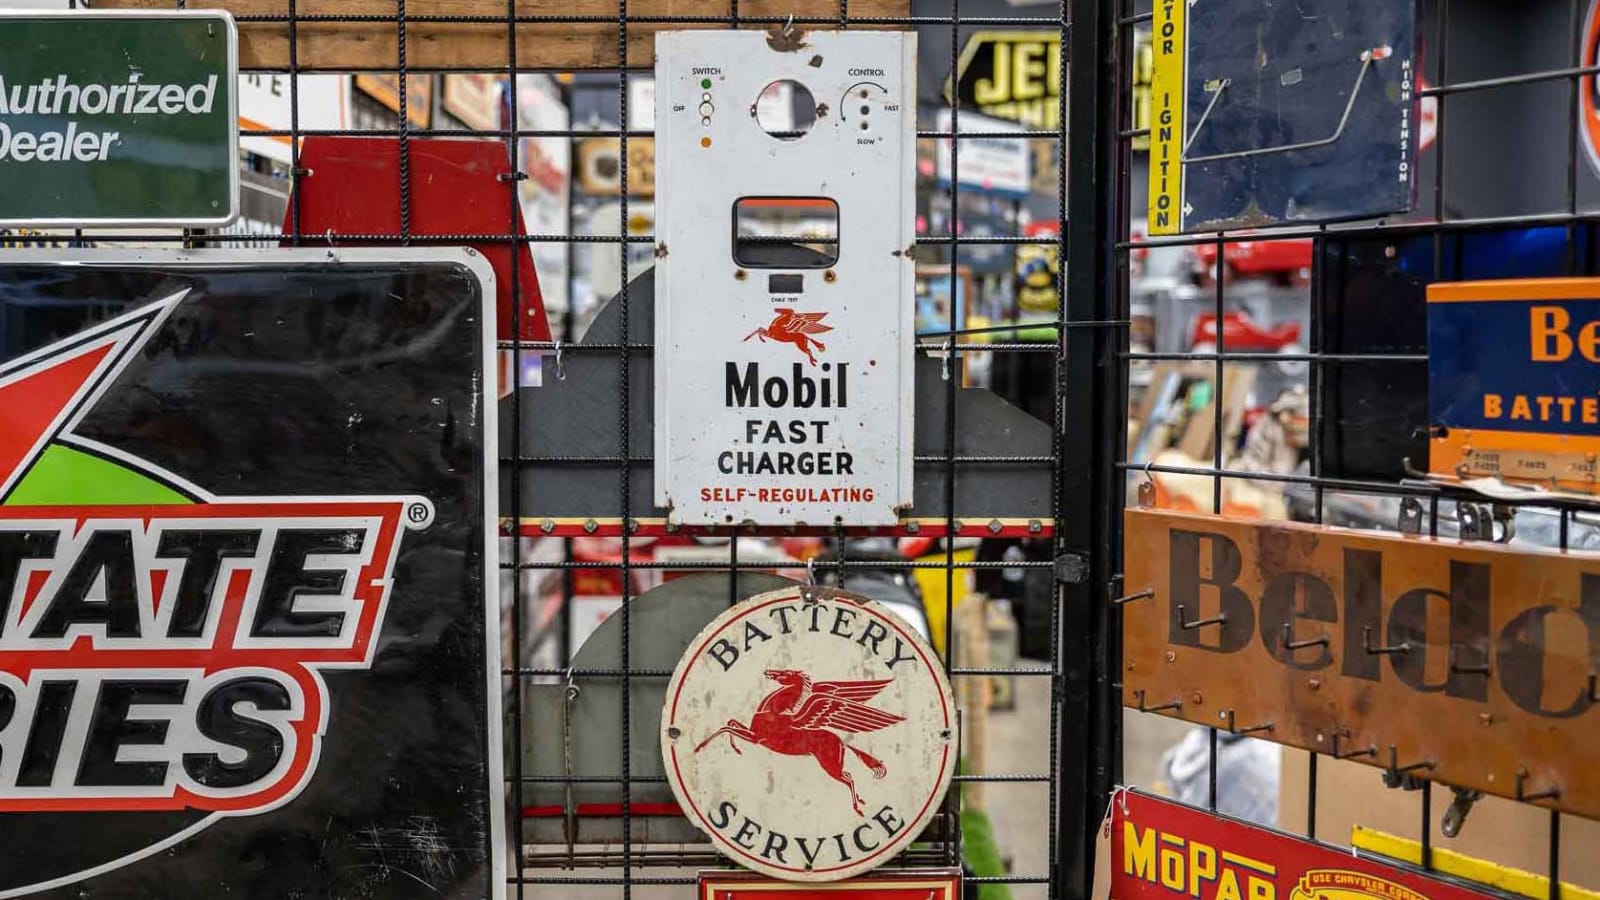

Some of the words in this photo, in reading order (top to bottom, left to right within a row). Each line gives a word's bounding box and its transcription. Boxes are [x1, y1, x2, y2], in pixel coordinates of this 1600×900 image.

[692, 67, 721, 75] SWITCH
[848, 68, 885, 76] CONTROL
[1401, 60, 1410, 101] HIGH
[1156, 93, 1173, 227] IGNITION
[1399, 108, 1409, 182] TENSION
[725, 361, 849, 408] Mobil
[746, 420, 829, 444] FAST
[717, 451, 853, 475] CHARGER
[700, 488, 874, 503] SELF-REGULATING
[707, 604, 917, 672] BATTERY
[0, 676, 292, 788] IES
[707, 801, 906, 864] SERVICE
[1313, 874, 1331, 883] USE
[1334, 875, 1385, 894] CHRYSLER
